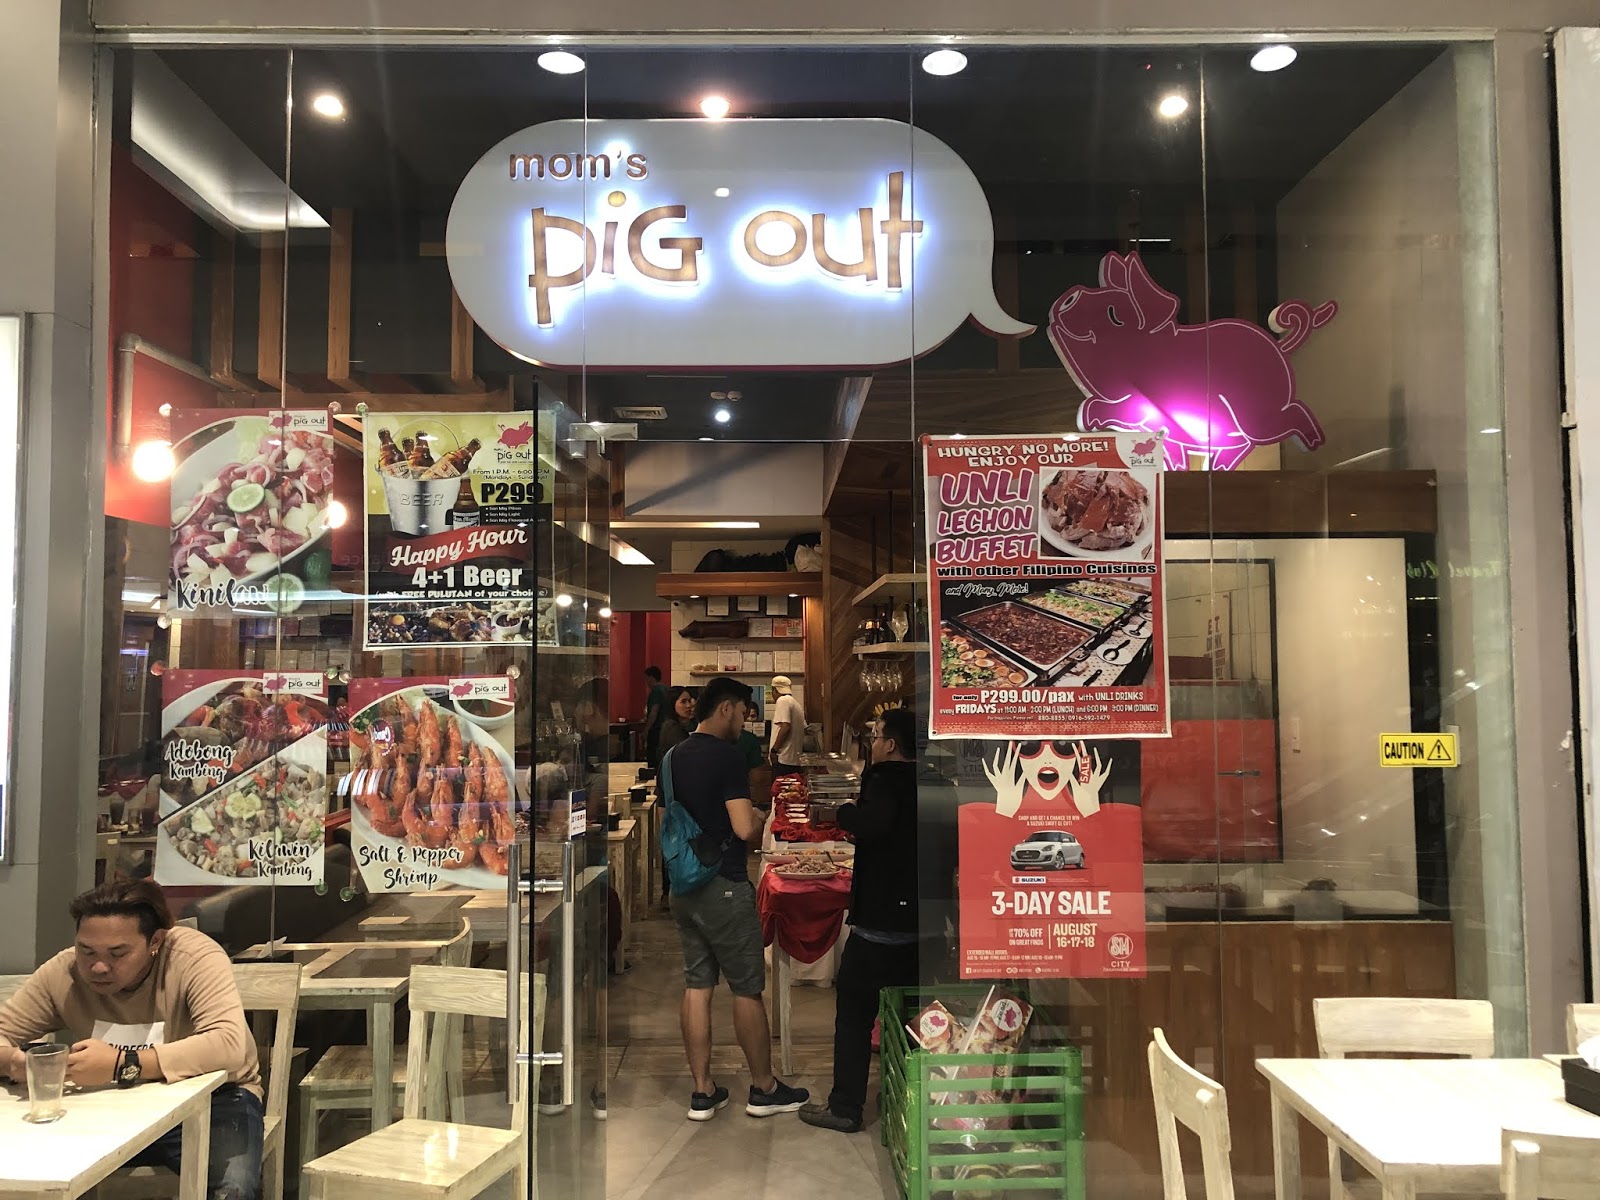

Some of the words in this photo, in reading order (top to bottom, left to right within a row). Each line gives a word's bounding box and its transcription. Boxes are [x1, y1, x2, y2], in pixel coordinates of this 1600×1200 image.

[509, 149, 648, 180] mom's
[743, 171, 924, 292] out
[311, 416, 326, 424] out
[516, 449, 532, 459] out
[938, 444, 1015, 458] HUNGRY
[1022, 444, 1048, 455] NO
[1053, 442, 1110, 453] MORE!
[968, 456, 1031, 468] ENJOY
[1038, 454, 1074, 464] OUR
[481, 482, 544, 503] P299
[940, 468, 1034, 506] UNLI
[400, 493, 444, 506] BEER
[938, 505, 1034, 536] LECHON
[390, 540, 465, 566] Happy
[467, 528, 528, 553] Hour
[936, 534, 1037, 565] BUFFET
[412, 566, 455, 588] 4+1
[464, 565, 522, 587] Beer
[936, 564, 972, 578] with
[975, 564, 1019, 576] other
[1022, 564, 1082, 576] Filipino
[1086, 562, 1157, 575] Cuisines
[428, 590, 472, 598] PULUTAN
[945, 584, 964, 596] and
[981, 689, 1075, 704] P299.00/pax
[1095, 692, 1114, 700] UNLI
[1115, 692, 1144, 700] DRINKS
[955, 704, 997, 714] FRIDAYS
[1052, 706, 1074, 714] (LUNCH)
[1134, 704, 1158, 712] (DINNER)
[164, 739, 236, 766] Adobong
[1384, 742, 1424, 759] CAUTION
[170, 762, 227, 784] Kambing
[1080, 757, 1090, 783] SALE
[250, 839, 312, 860] Kilawin
[359, 845, 391, 867] Salt
[396, 846, 407, 862] &
[412, 846, 464, 868] Pepper
[259, 860, 312, 881] Kambing
[384, 869, 440, 891] Shrimp
[992, 891, 1054, 915] 3-DAY
[1058, 891, 1111, 915] SALE
[1014, 928, 1029, 938] 70%
[1030, 928, 1043, 937] OFF
[1053, 923, 1097, 936] AUGUST
